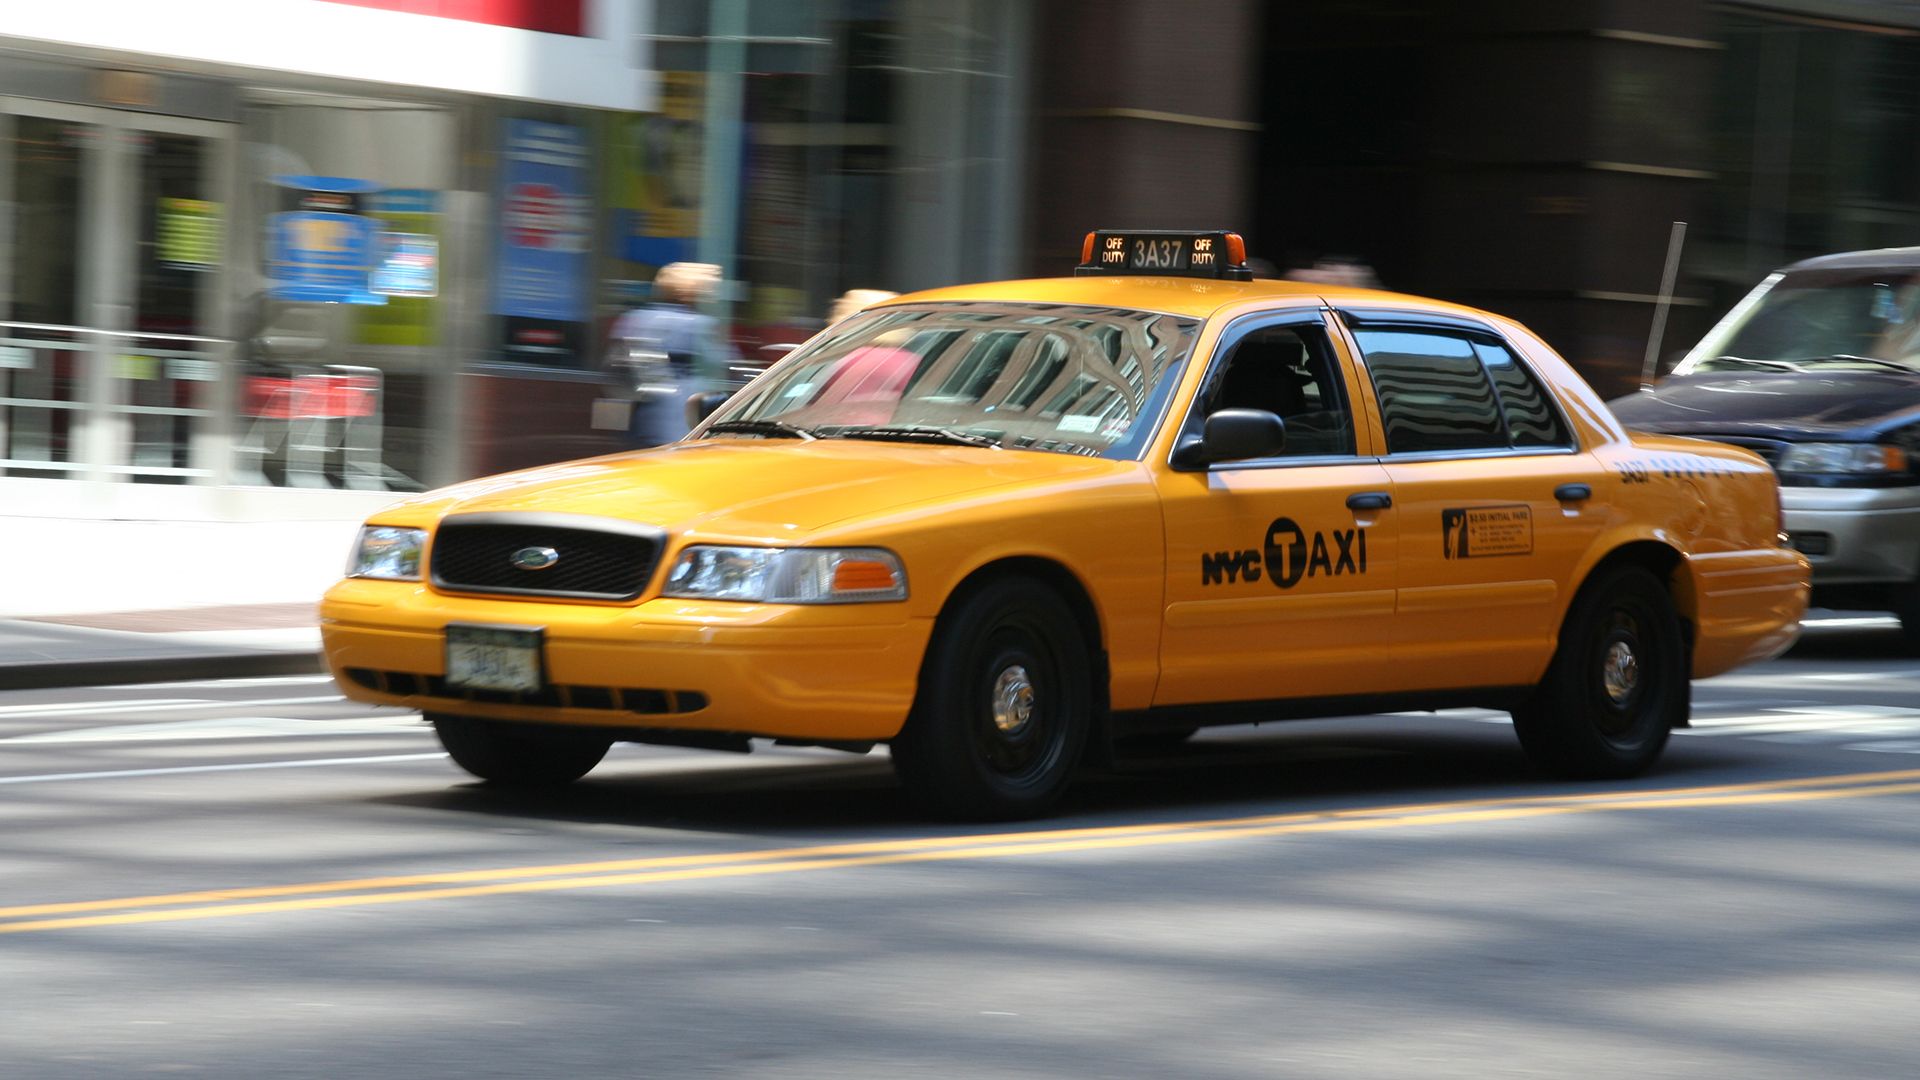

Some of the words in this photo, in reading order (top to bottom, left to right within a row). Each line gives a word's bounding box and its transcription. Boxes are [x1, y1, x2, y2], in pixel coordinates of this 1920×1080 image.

[1106, 237, 1123, 250] OFF
[1194, 239, 1212, 251] OFF
[1102, 251, 1126, 263] DUTY
[1135, 240, 1182, 268] 3A37
[1192, 252, 1216, 265] DUTY
[1202, 549, 1262, 586] NYC
[1267, 522, 1367, 585] TAXI
